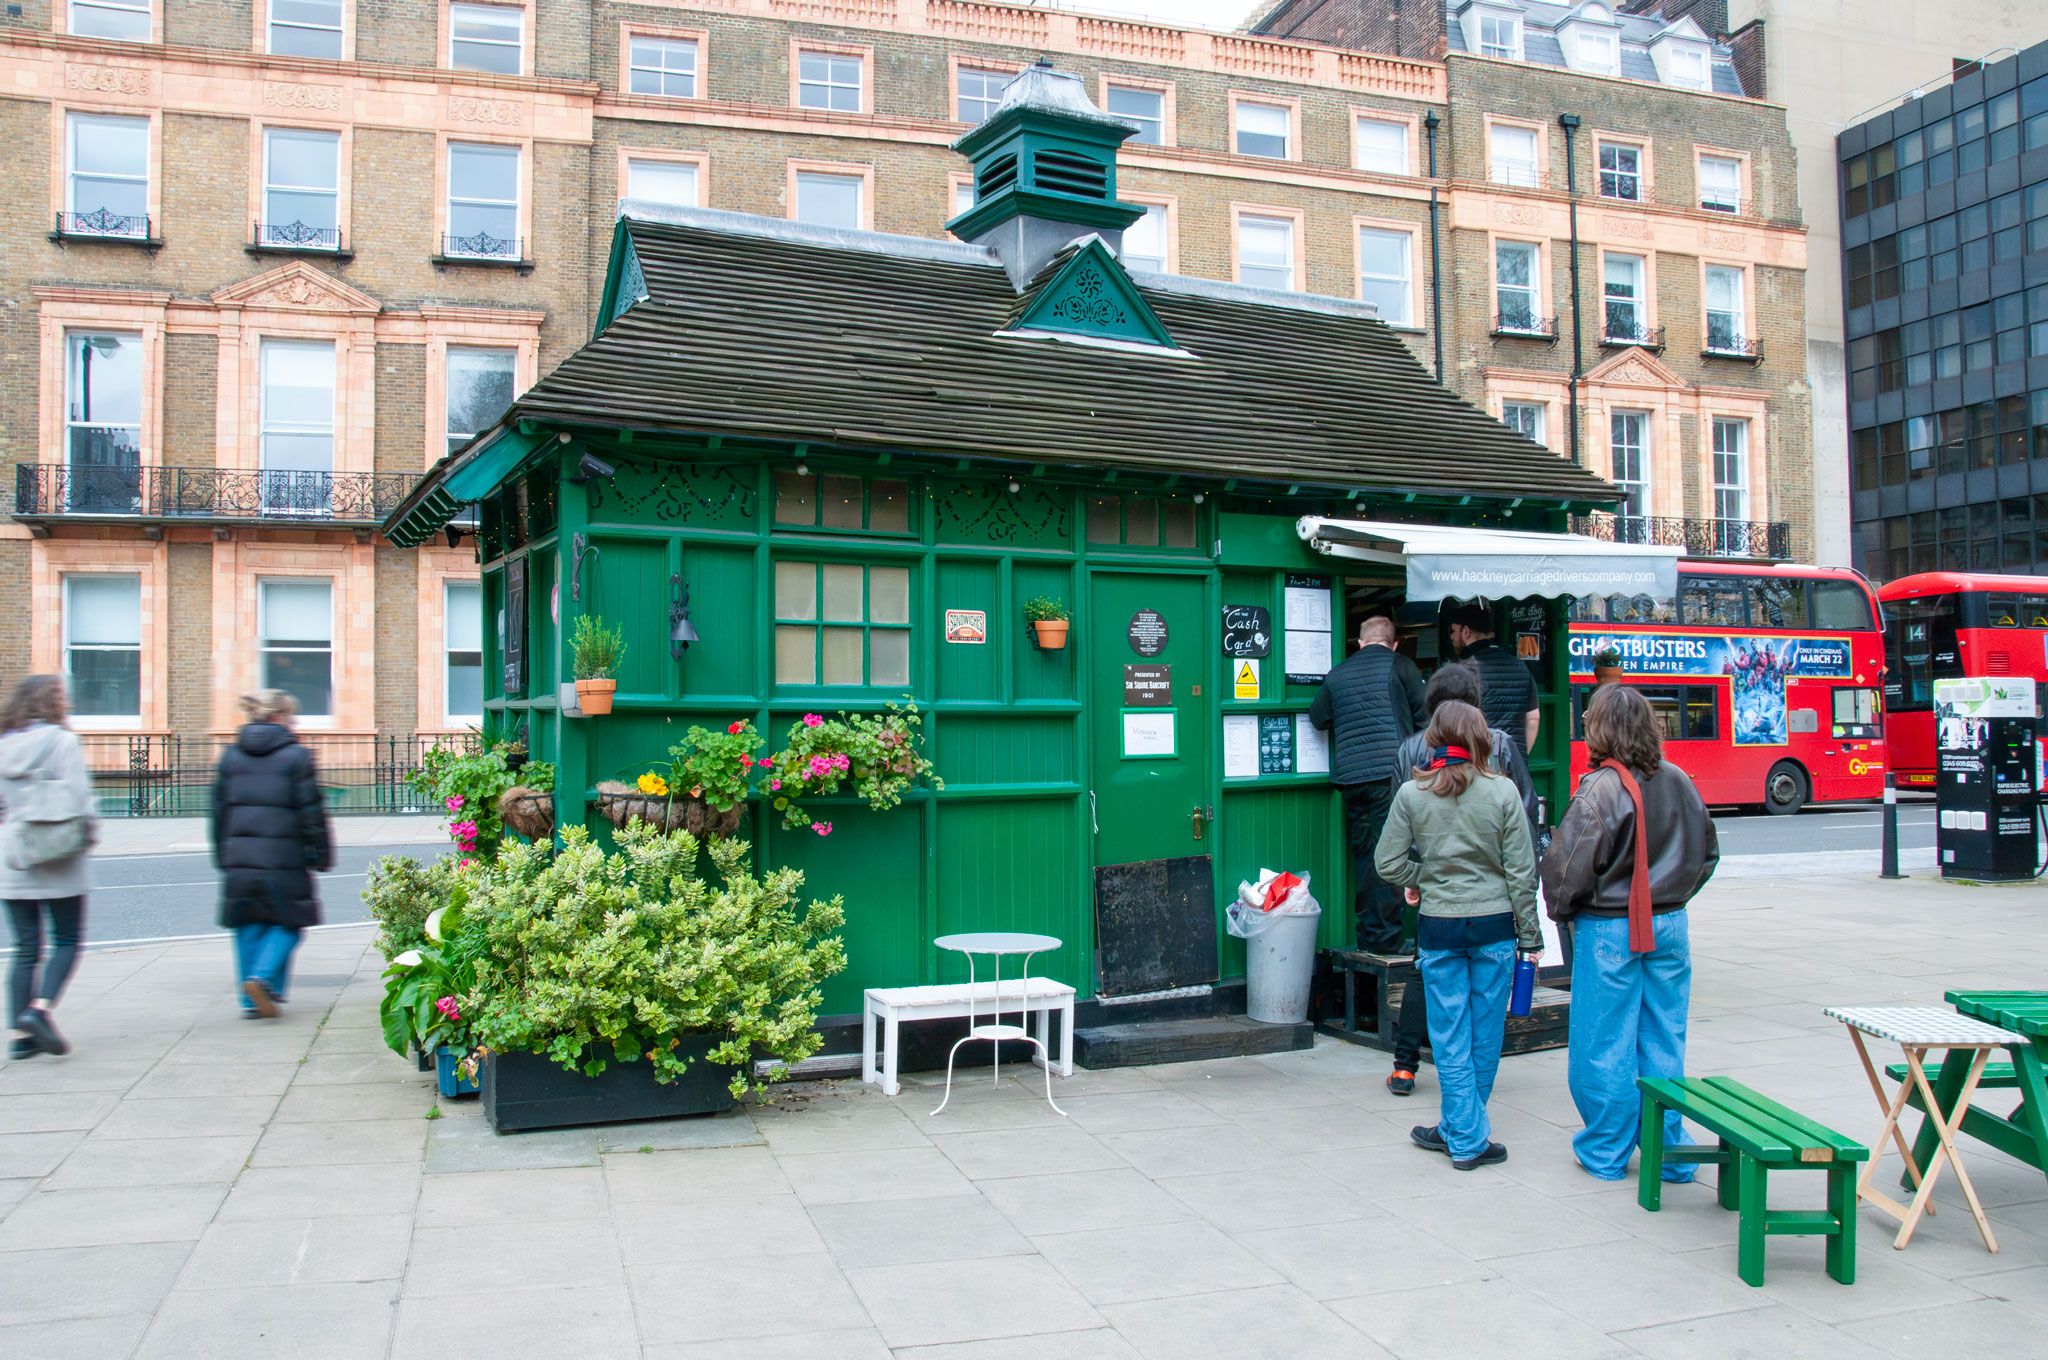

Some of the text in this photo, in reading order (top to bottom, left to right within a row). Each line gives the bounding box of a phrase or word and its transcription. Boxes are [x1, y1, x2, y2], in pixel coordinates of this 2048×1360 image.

[1432, 568, 1656, 586] www.hackneycarriagedriverscompany.com
[950, 614, 983, 633] SANDWICHES
[1226, 608, 1259, 630] Cash
[1224, 633, 1253, 651] Card
[1909, 627, 1924, 640] 14
[1643, 661, 1684, 670] EMPIRE
[1800, 655, 1843, 664] MARCH 22
[1149, 681, 1169, 689] BANCROFT
[1849, 758, 1868, 775] Go
